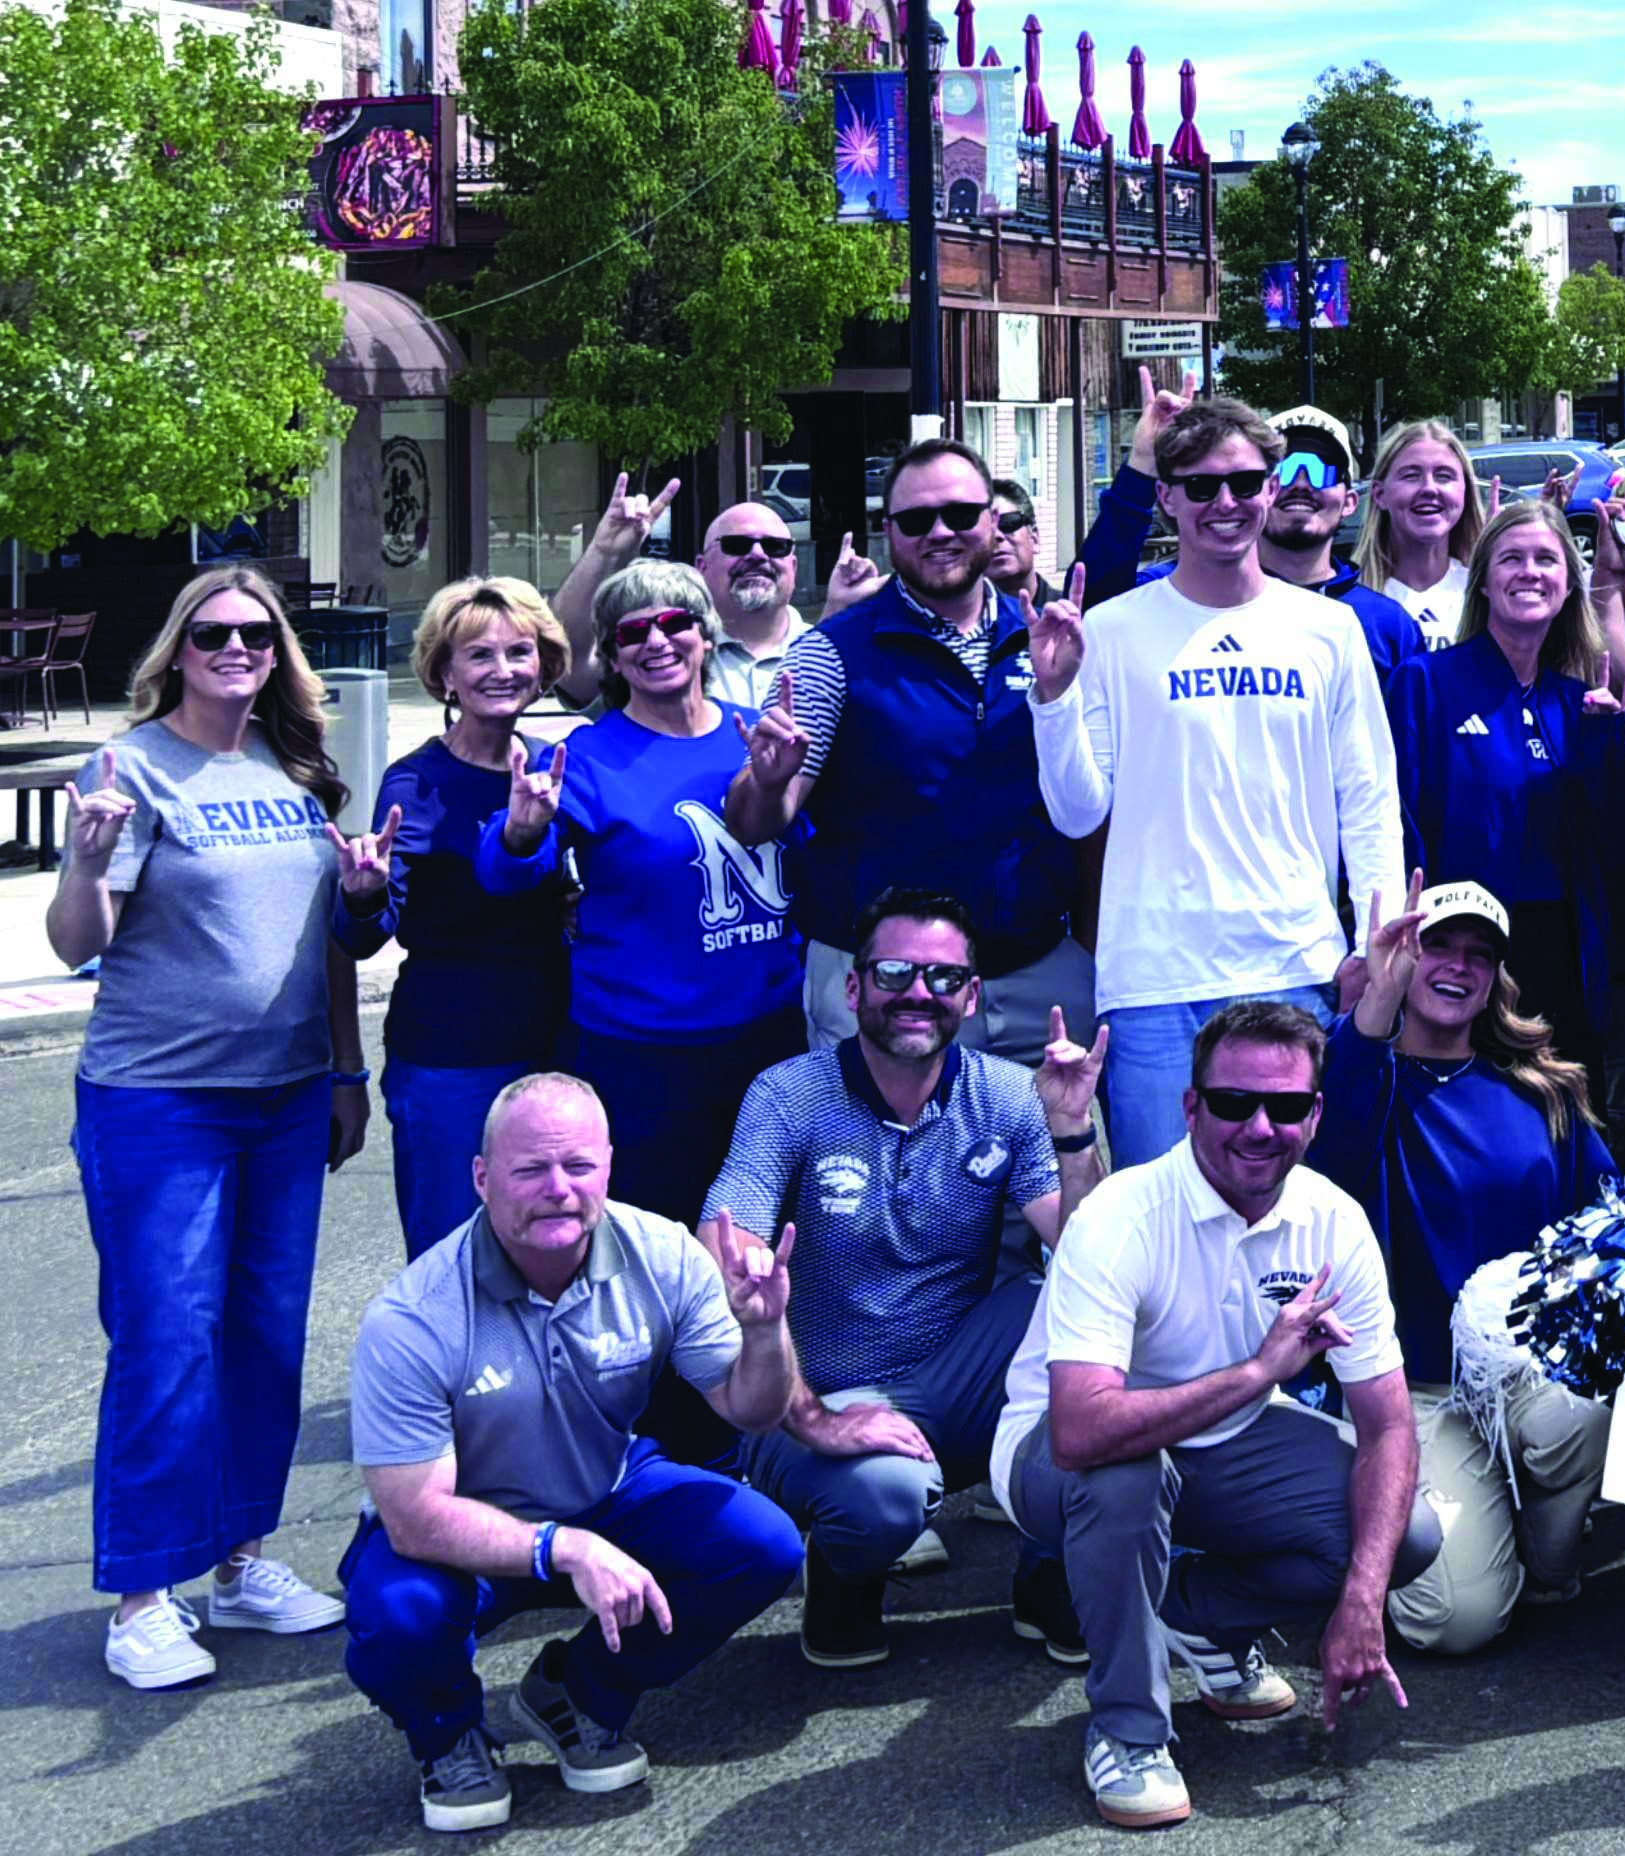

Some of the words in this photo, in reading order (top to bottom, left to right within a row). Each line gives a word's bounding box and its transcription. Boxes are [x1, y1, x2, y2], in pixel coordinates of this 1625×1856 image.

[1168, 666, 1306, 700] NEVADA
[186, 828, 272, 850] SOFTBALL
[674, 800, 794, 930] N
[1433, 890, 1471, 908] WOLF
